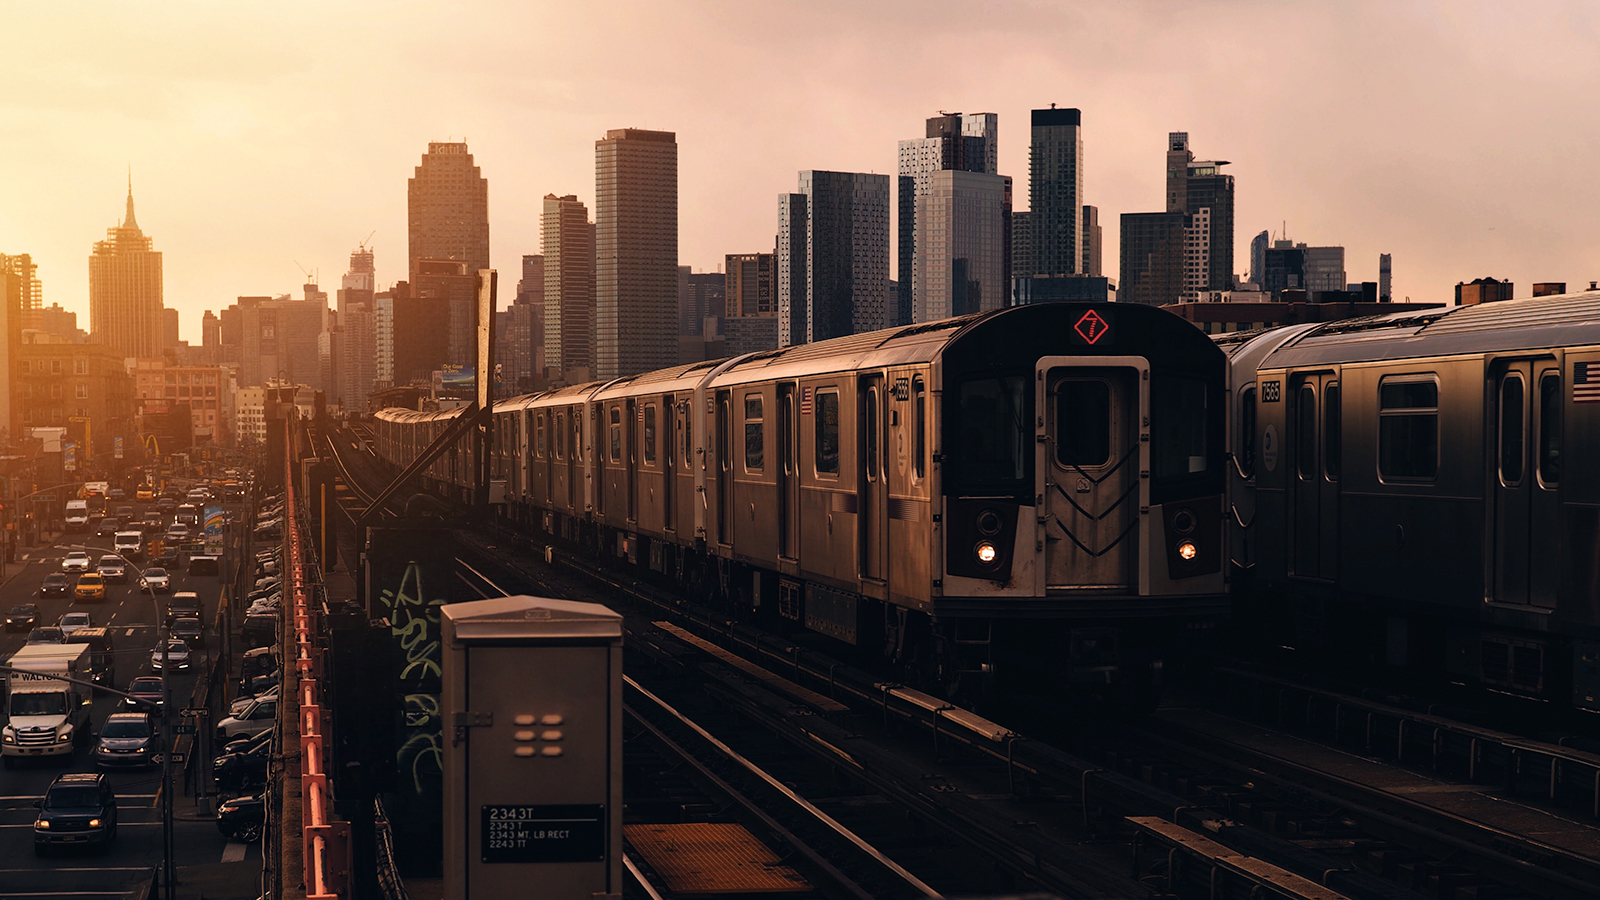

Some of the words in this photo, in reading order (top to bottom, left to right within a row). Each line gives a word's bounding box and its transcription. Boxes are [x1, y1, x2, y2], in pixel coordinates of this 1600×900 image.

[1085, 317, 1097, 338] 7
[1262, 382, 1279, 401] 7565
[490, 822, 515, 830] 2343
[517, 822, 522, 830] T
[490, 831, 515, 839] 2343
[534, 830, 545, 838] LB
[548, 830, 569, 838] RECT
[490, 840, 514, 848] 2243
[517, 840, 526, 848] TT
